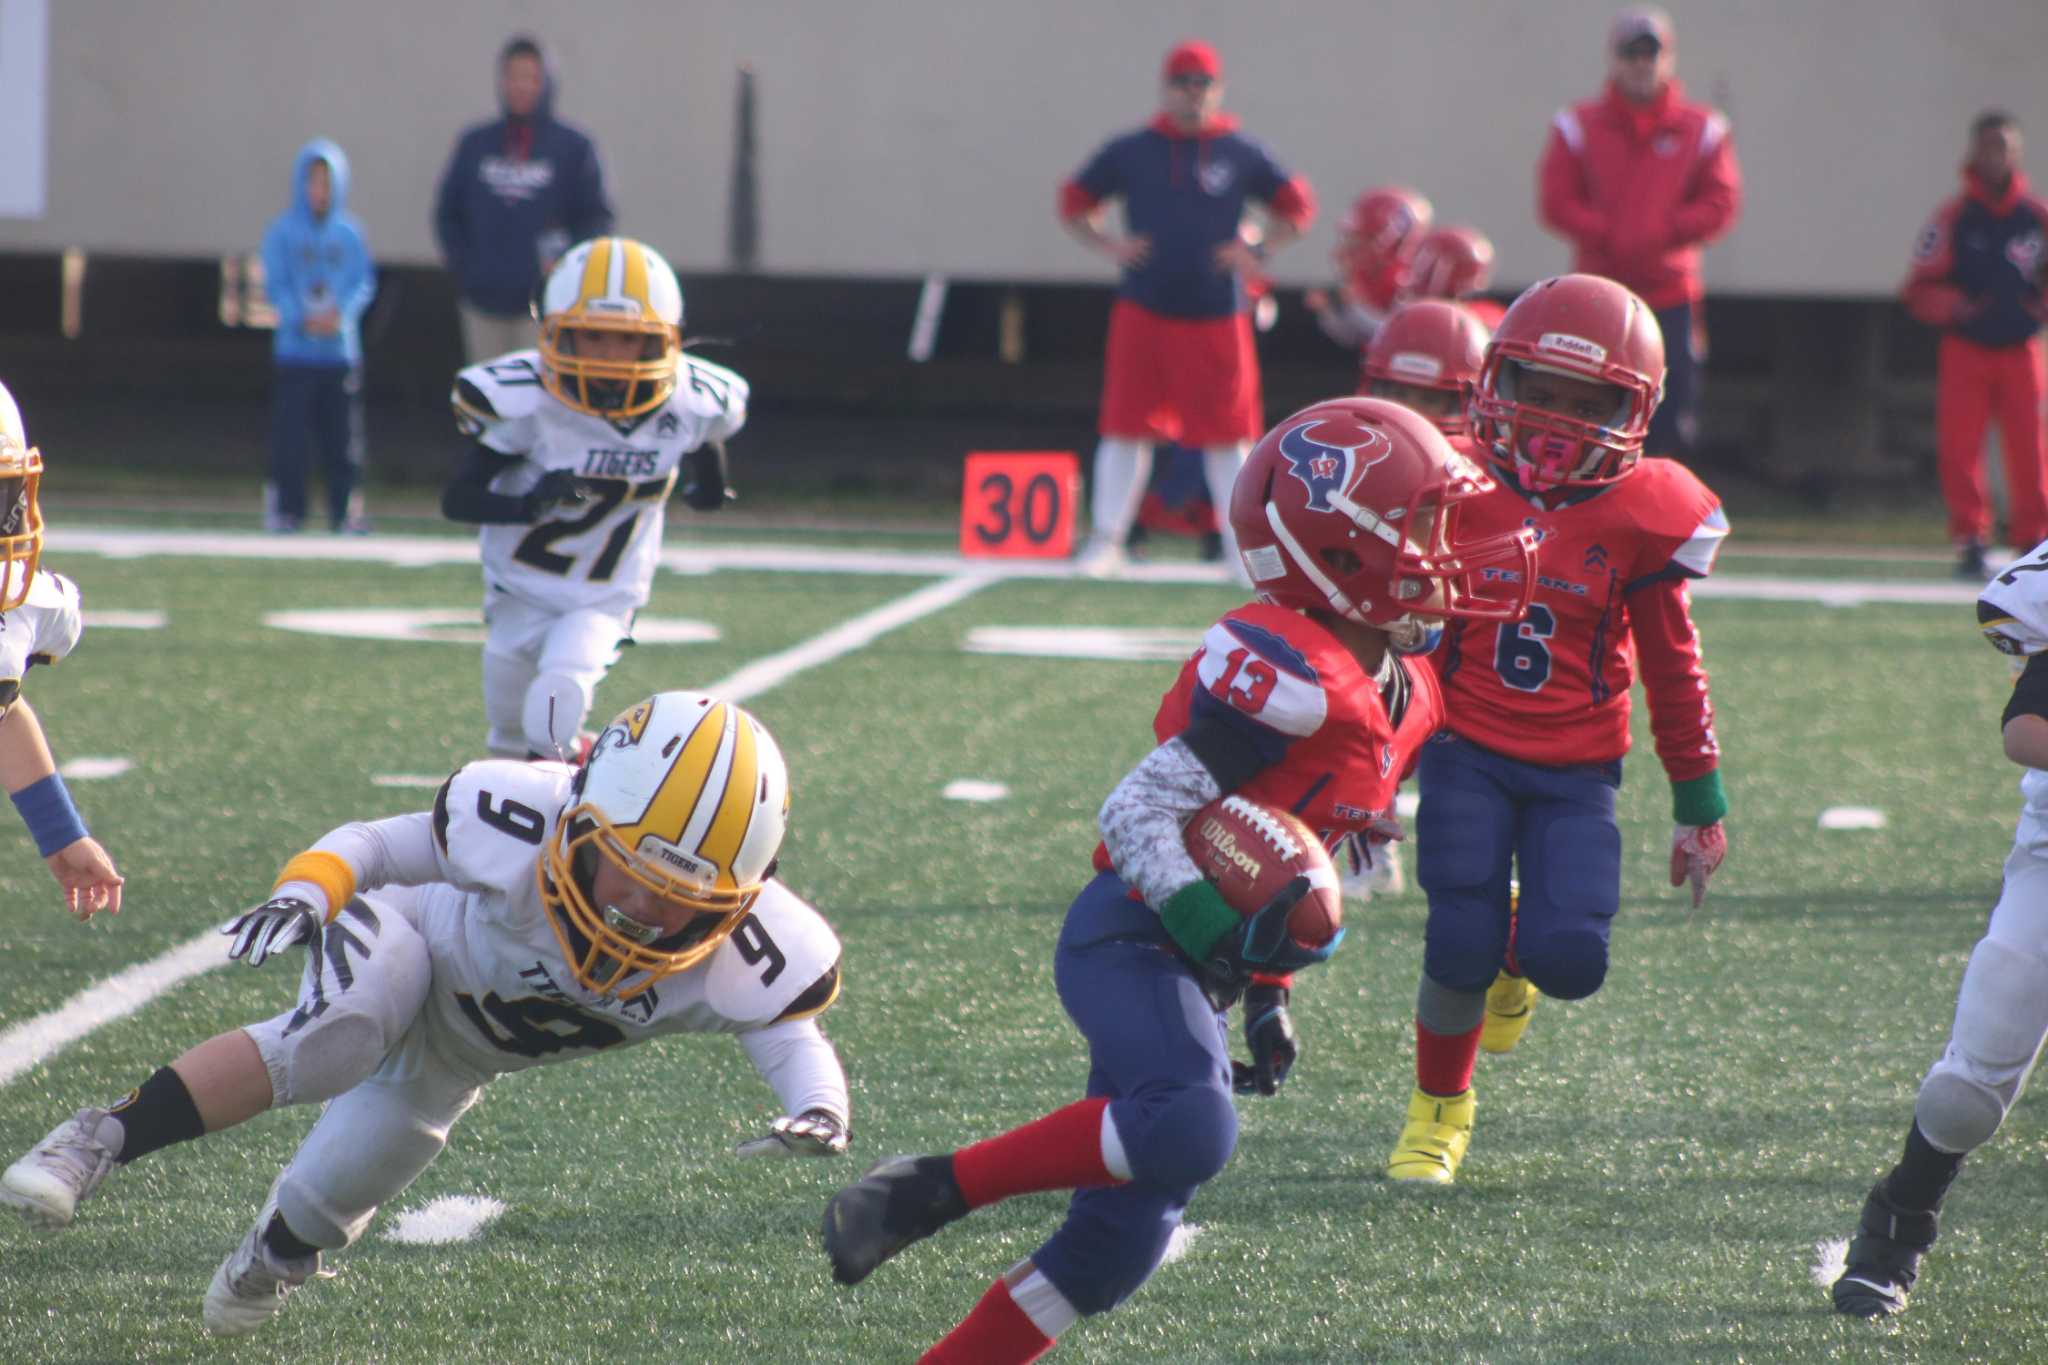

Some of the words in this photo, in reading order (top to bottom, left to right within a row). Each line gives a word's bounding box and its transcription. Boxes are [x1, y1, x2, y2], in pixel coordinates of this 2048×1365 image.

[583, 448, 660, 477] TIGERS
[975, 471, 1060, 546] 30
[1482, 567, 1590, 596] TEANS
[1493, 601, 1556, 693] 6
[1209, 647, 1279, 715] 13
[660, 847, 698, 874] TIGERS
[1200, 816, 1262, 880] Wilson
[730, 911, 786, 988] 9
